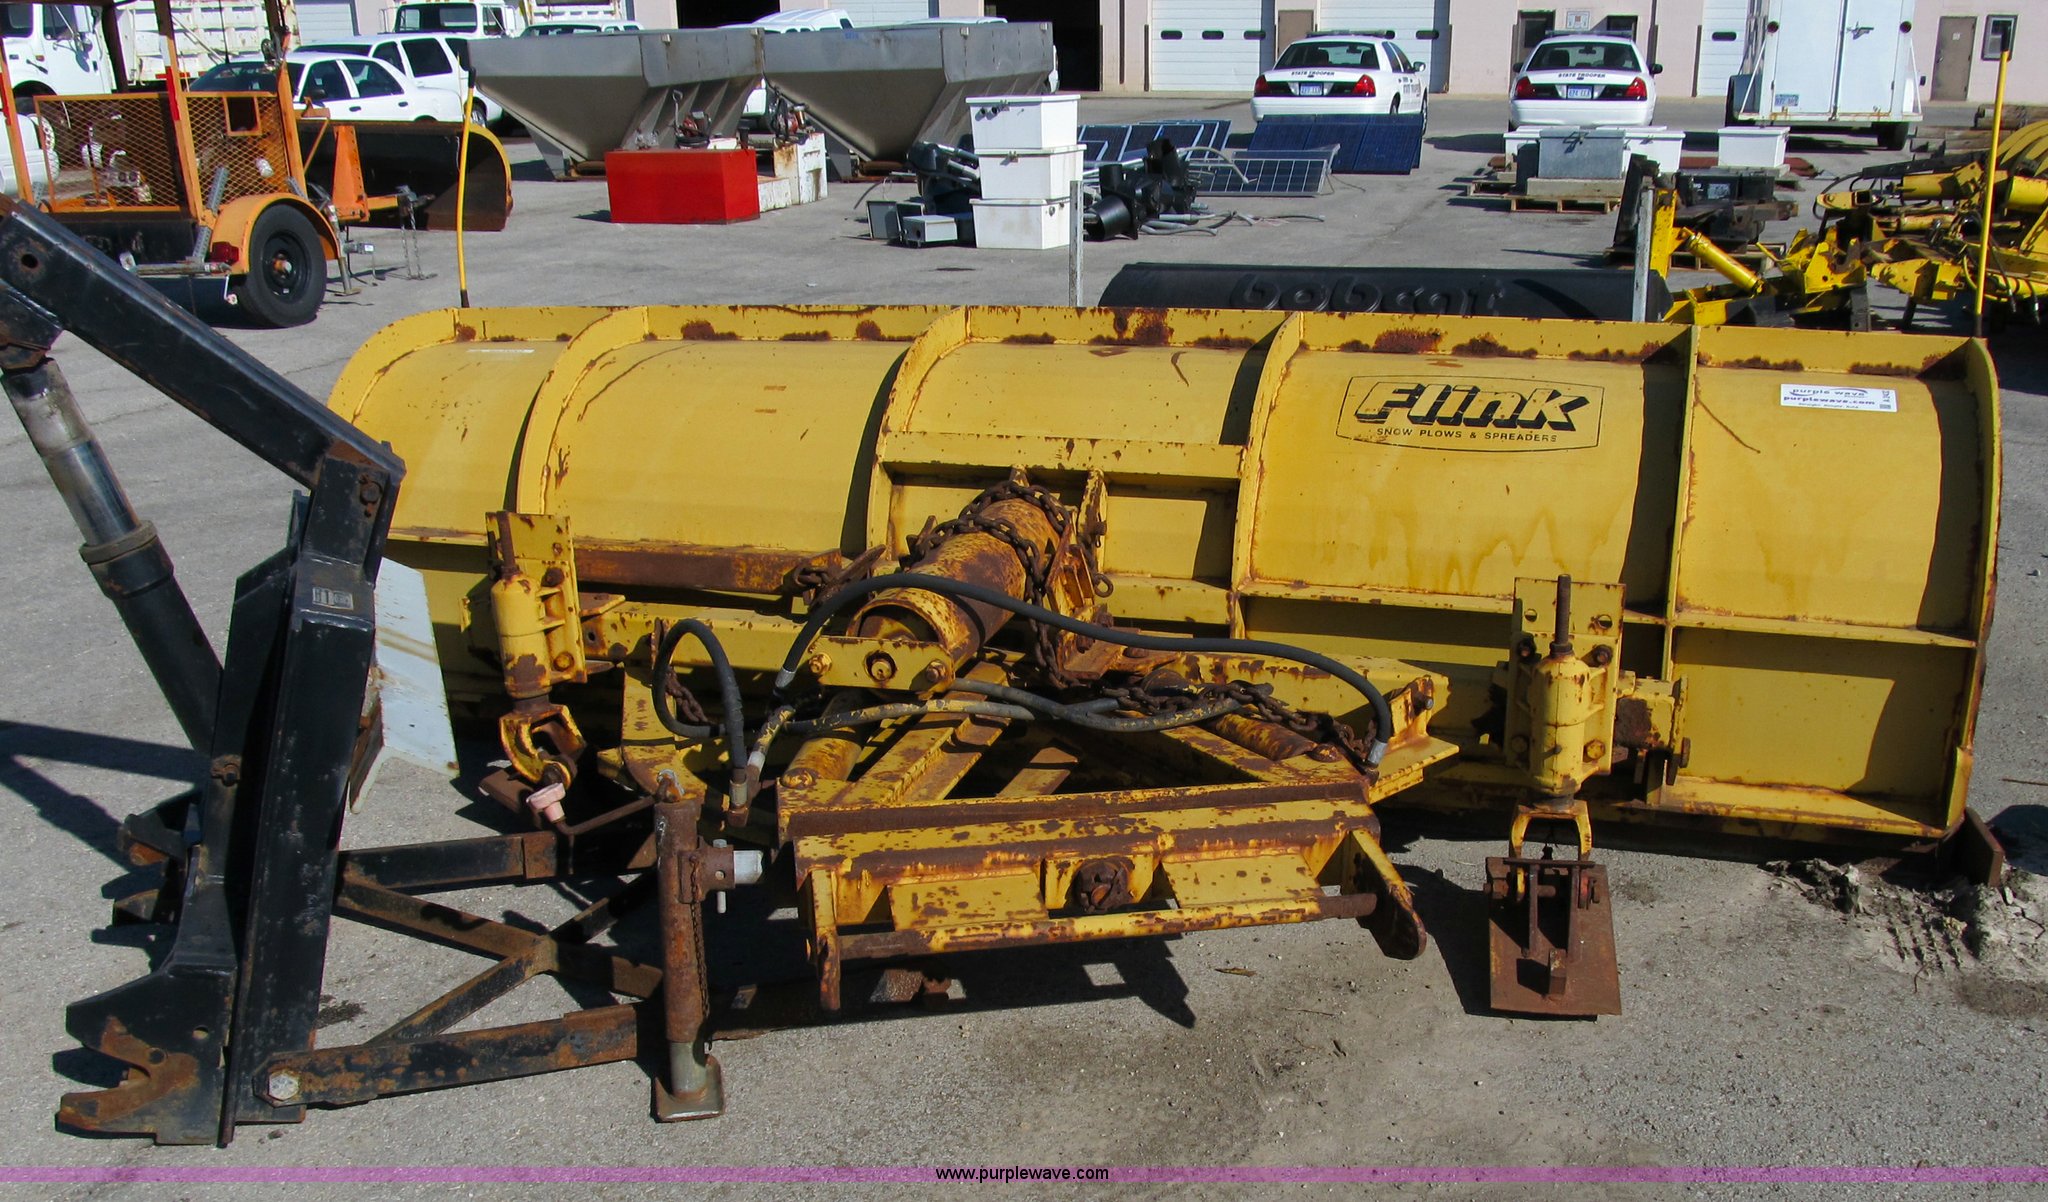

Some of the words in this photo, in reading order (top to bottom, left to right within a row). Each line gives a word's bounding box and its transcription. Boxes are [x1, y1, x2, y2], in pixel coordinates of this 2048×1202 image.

[1354, 382, 1590, 431] Flink
[1783, 395, 1875, 405] purplewave.com
[1377, 427, 1413, 437] SNOW
[1419, 429, 1462, 439] PLOWS
[1469, 431, 1477, 439] &
[1484, 431, 1557, 443] SPREADERS
